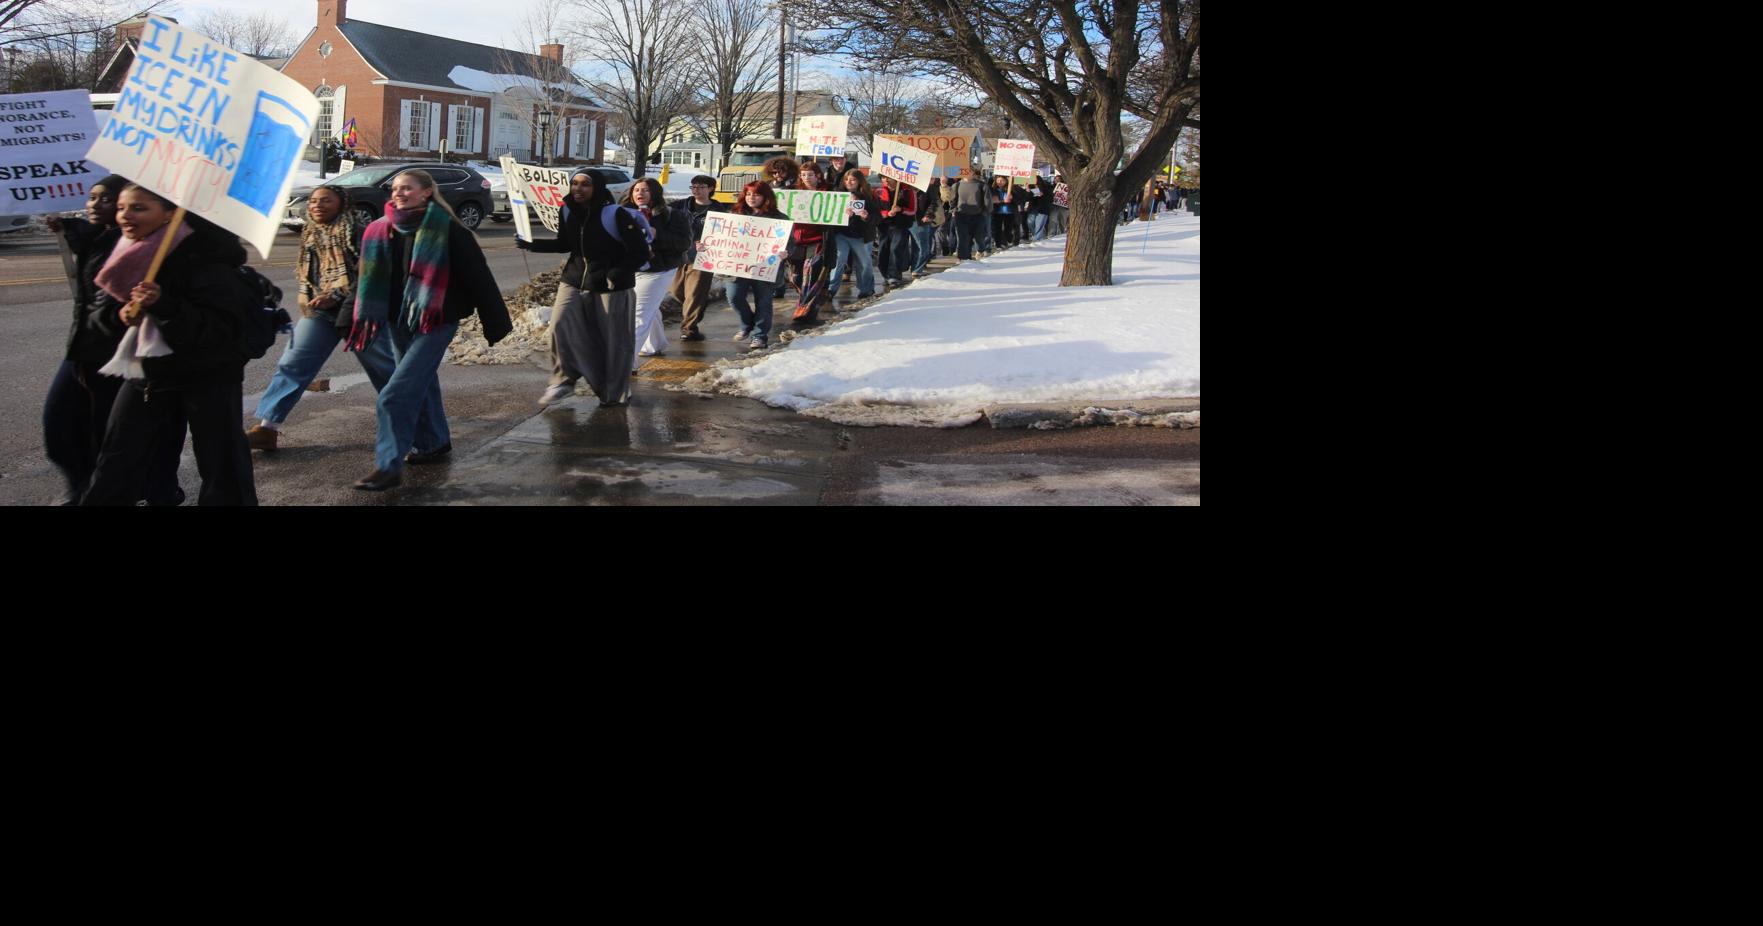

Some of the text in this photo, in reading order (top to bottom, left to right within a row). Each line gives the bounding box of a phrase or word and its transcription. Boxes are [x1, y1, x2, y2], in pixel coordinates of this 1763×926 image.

[144, 17, 170, 52] I
[0, 100, 46, 111] FIGHT
[178, 77, 231, 125] IN
[13, 124, 45, 134] NOT
[102, 118, 156, 155] NOT
[908, 136, 965, 151] 10:00
[0, 160, 91, 180] SPEAK
[882, 151, 920, 175] ICE
[880, 165, 916, 184] CRUSHED
[9, 182, 85, 200] UP!!!!
[530, 184, 566, 207] ICE
[810, 192, 849, 224] OUT
[709, 217, 776, 238] THE REAL
[757, 242, 768, 254] IS
